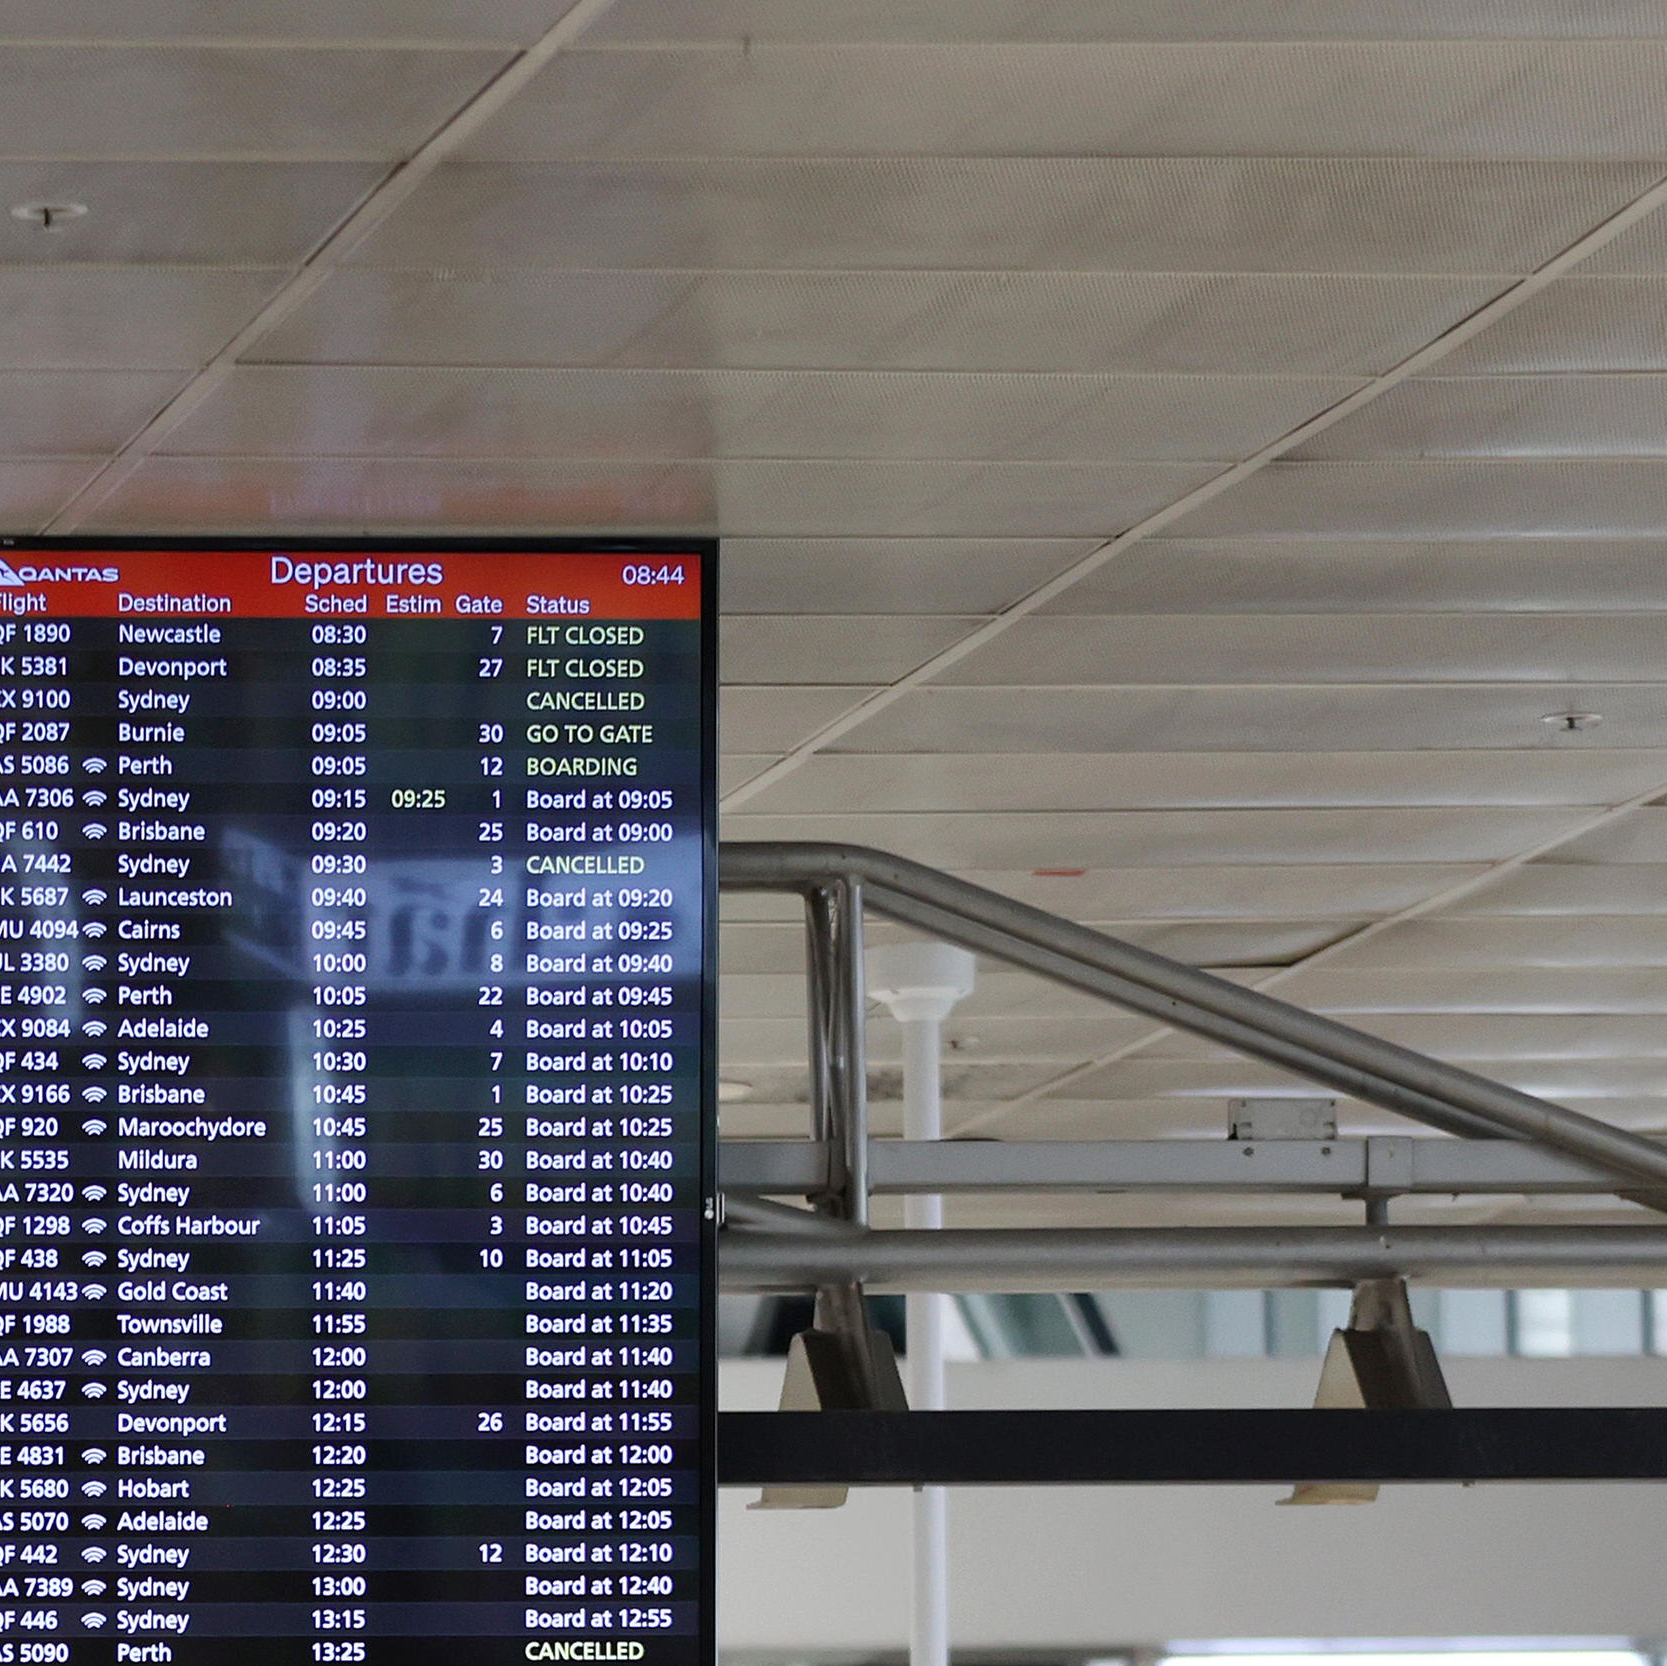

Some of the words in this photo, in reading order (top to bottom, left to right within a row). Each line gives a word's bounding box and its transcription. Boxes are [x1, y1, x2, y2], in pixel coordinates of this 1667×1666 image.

[20, 566, 119, 586] QANTAS
[271, 556, 443, 590] Departures
[622, 565, 685, 585] 08:44
[118, 593, 231, 613] Destination
[304, 593, 367, 613] Sched
[386, 594, 441, 613] Estim
[455, 594, 503, 614] Gate
[526, 595, 590, 614] Status
[23, 623, 71, 643] 1890
[119, 623, 221, 644] Newcastle
[311, 625, 367, 644] 08:30
[491, 626, 503, 645] 7
[527, 626, 560, 645] FLT
[565, 626, 644, 645] CLOSED
[25, 788, 74, 808] 7306
[118, 787, 190, 813] Sydney
[311, 788, 366, 809] 09:15
[391, 789, 446, 809] 09:25
[492, 789, 501, 809] 1
[526, 789, 586, 809] Board
[592, 791, 613, 809] at
[618, 790, 673, 809] 09:05
[19, 1642, 69, 1663] 5090
[117, 1641, 172, 1663] Perth
[312, 1641, 366, 1662] 13:25
[524, 1641, 645, 1661] CANCELLED
